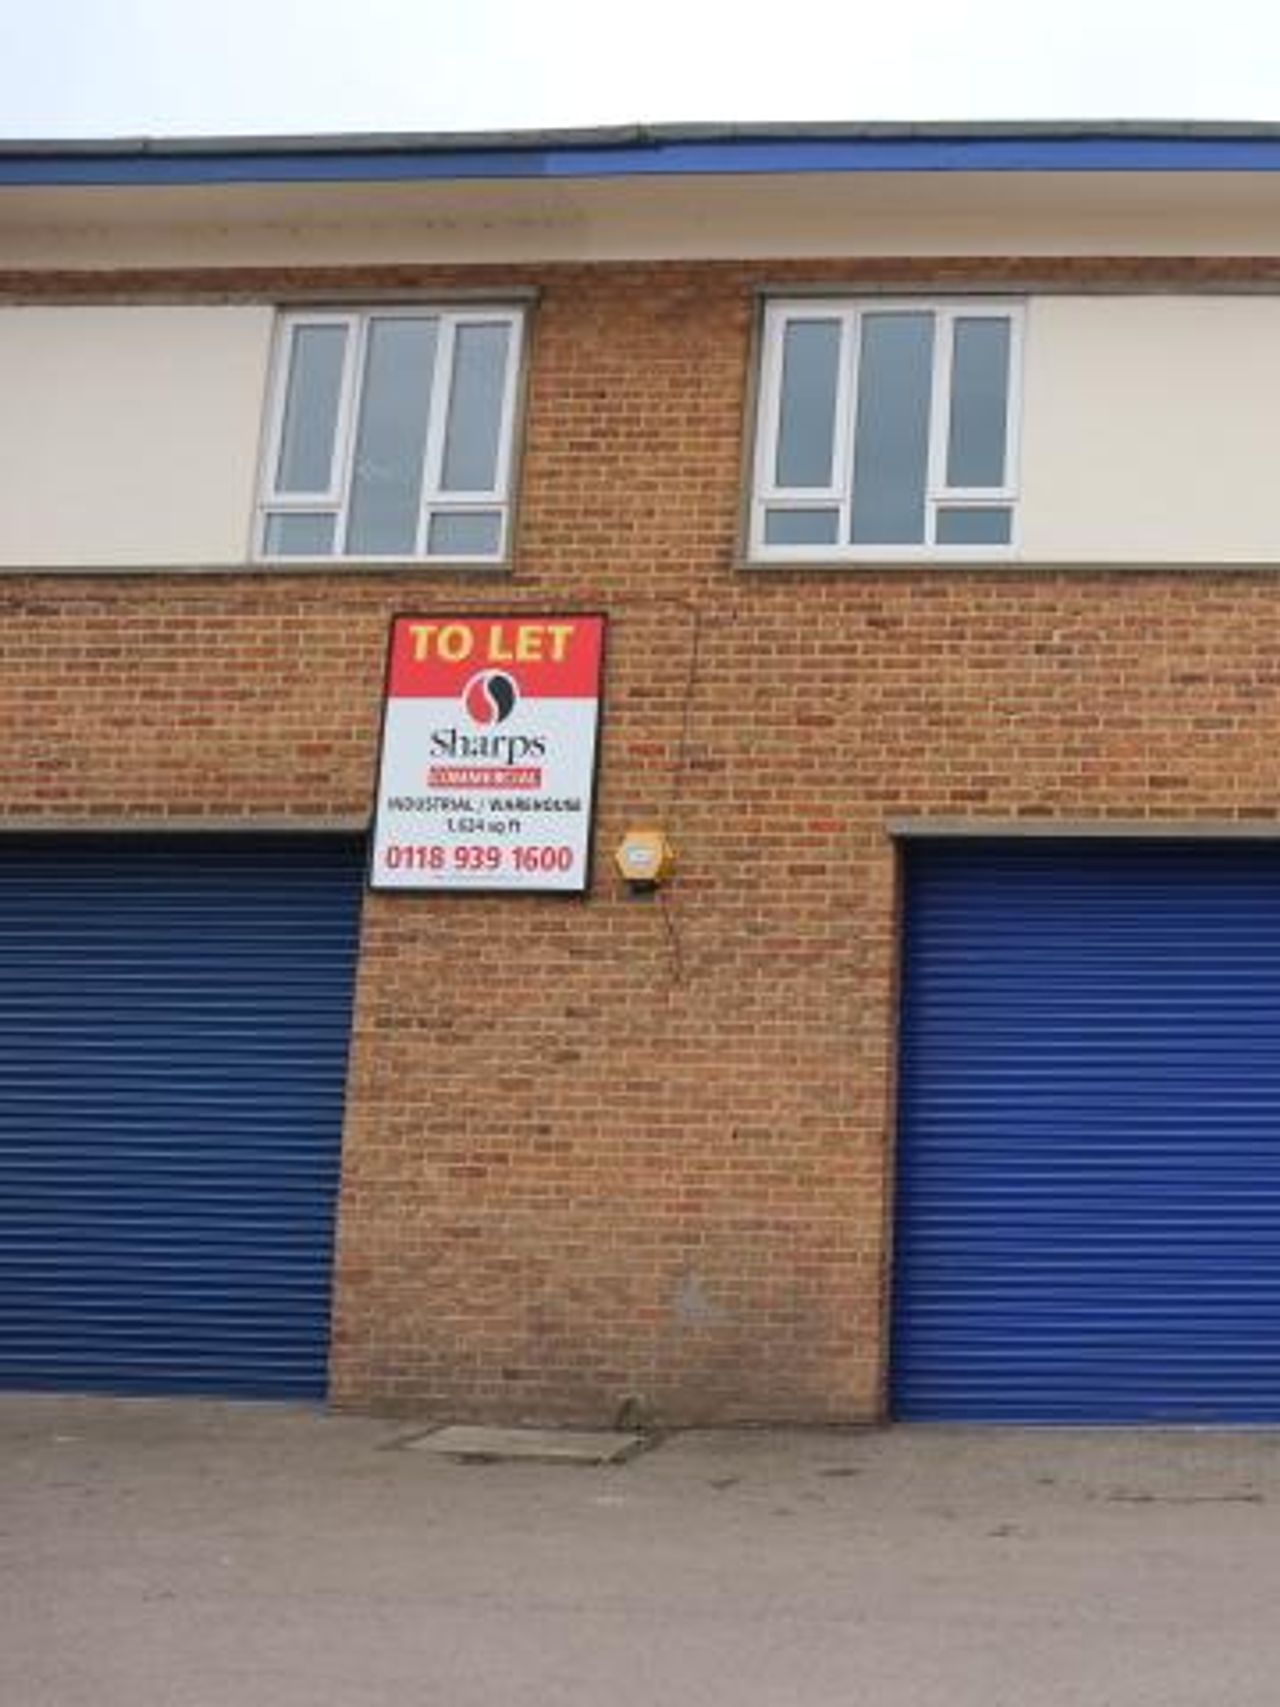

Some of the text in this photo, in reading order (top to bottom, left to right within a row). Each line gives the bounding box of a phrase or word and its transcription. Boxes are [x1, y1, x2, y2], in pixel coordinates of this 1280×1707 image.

[409, 624, 574, 662] TO LET
[430, 729, 546, 764] sharps
[387, 797, 474, 812] INDUSTRIAL
[489, 796, 581, 812] WAREHOUSE
[508, 818, 521, 833] ft
[386, 846, 574, 872] 0118 939 1600
